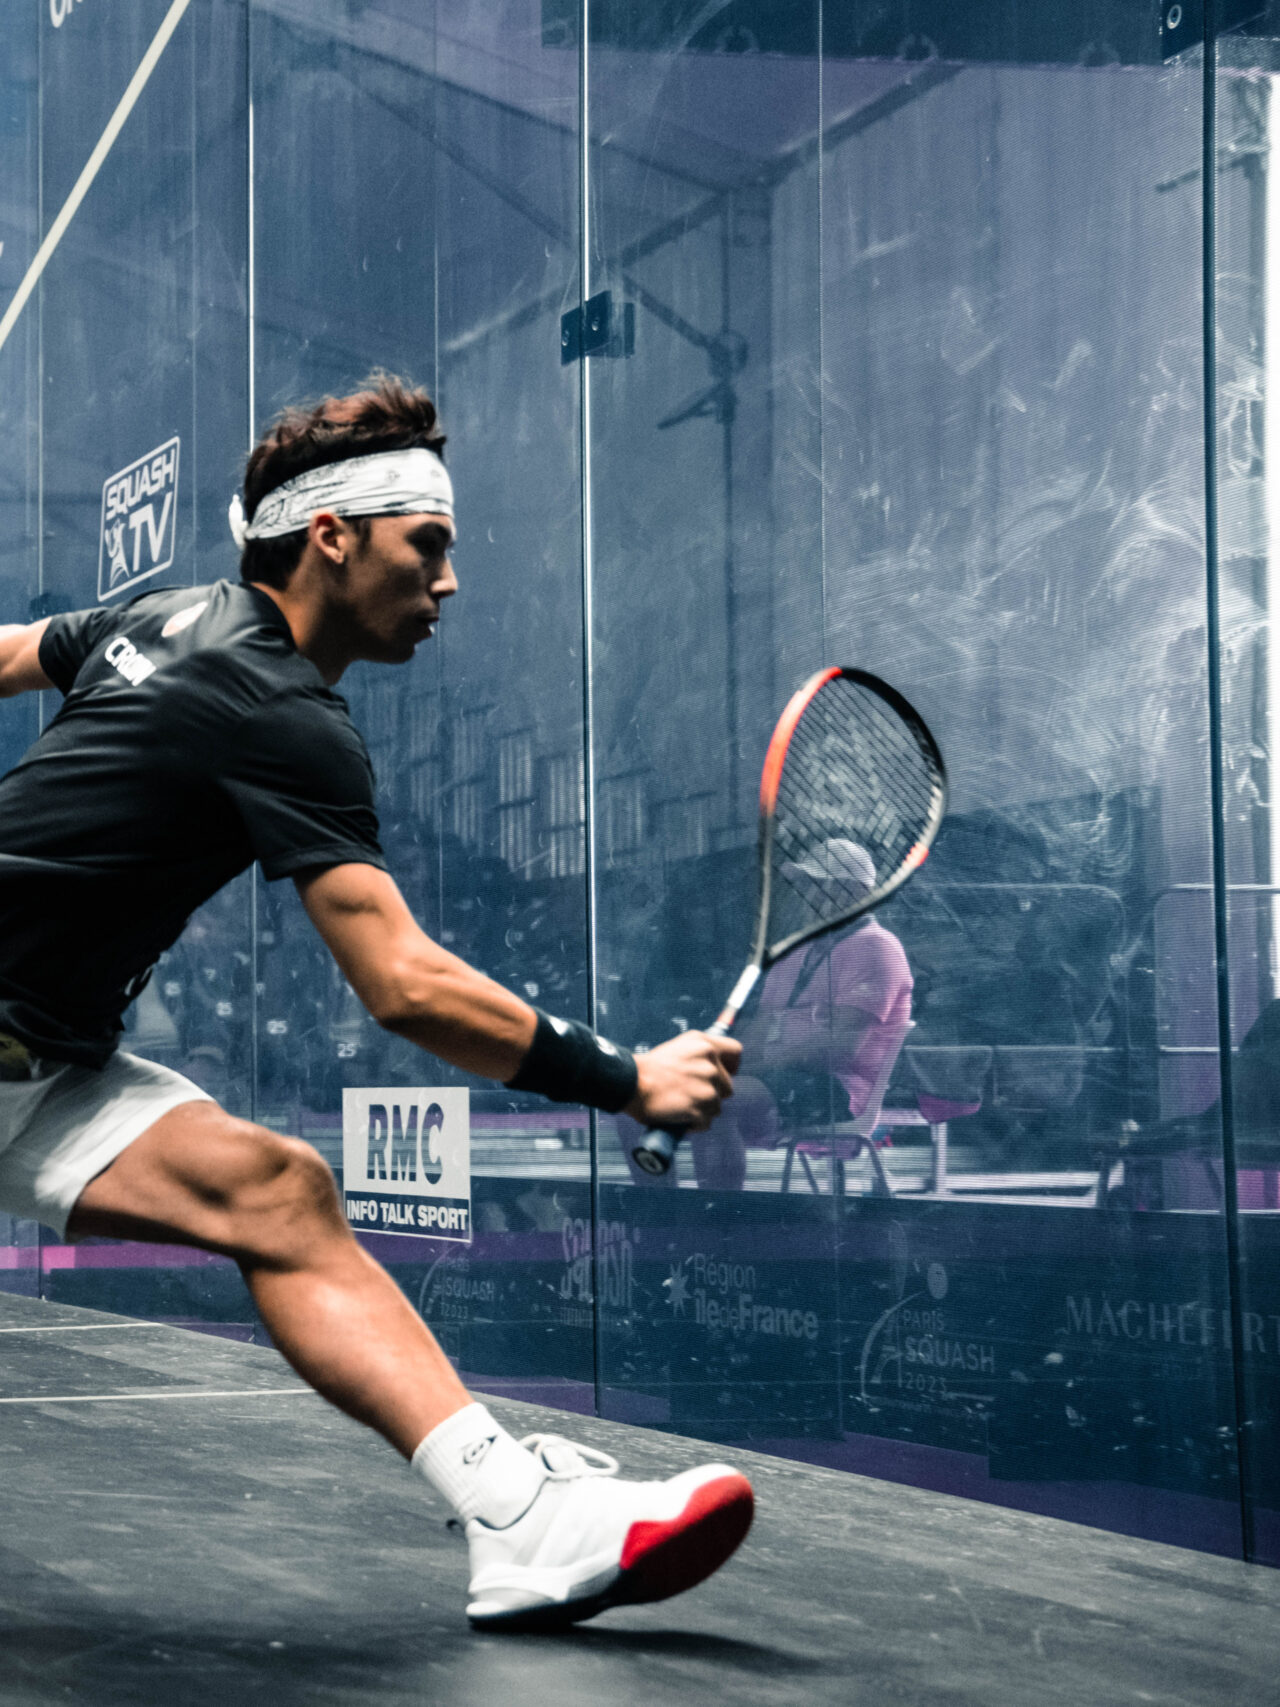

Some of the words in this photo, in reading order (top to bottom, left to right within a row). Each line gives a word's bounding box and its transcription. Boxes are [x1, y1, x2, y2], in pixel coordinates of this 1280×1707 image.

[106, 448, 175, 521] SQUASH
[129, 491, 173, 573] TV
[367, 1103, 445, 1185] RMC
[347, 1200, 378, 1221] INFO
[380, 1202, 415, 1225] TALK
[418, 1205, 468, 1231] SPORT
[904, 1336, 995, 1374] SQUASH
[905, 1371, 948, 1394] 2023
